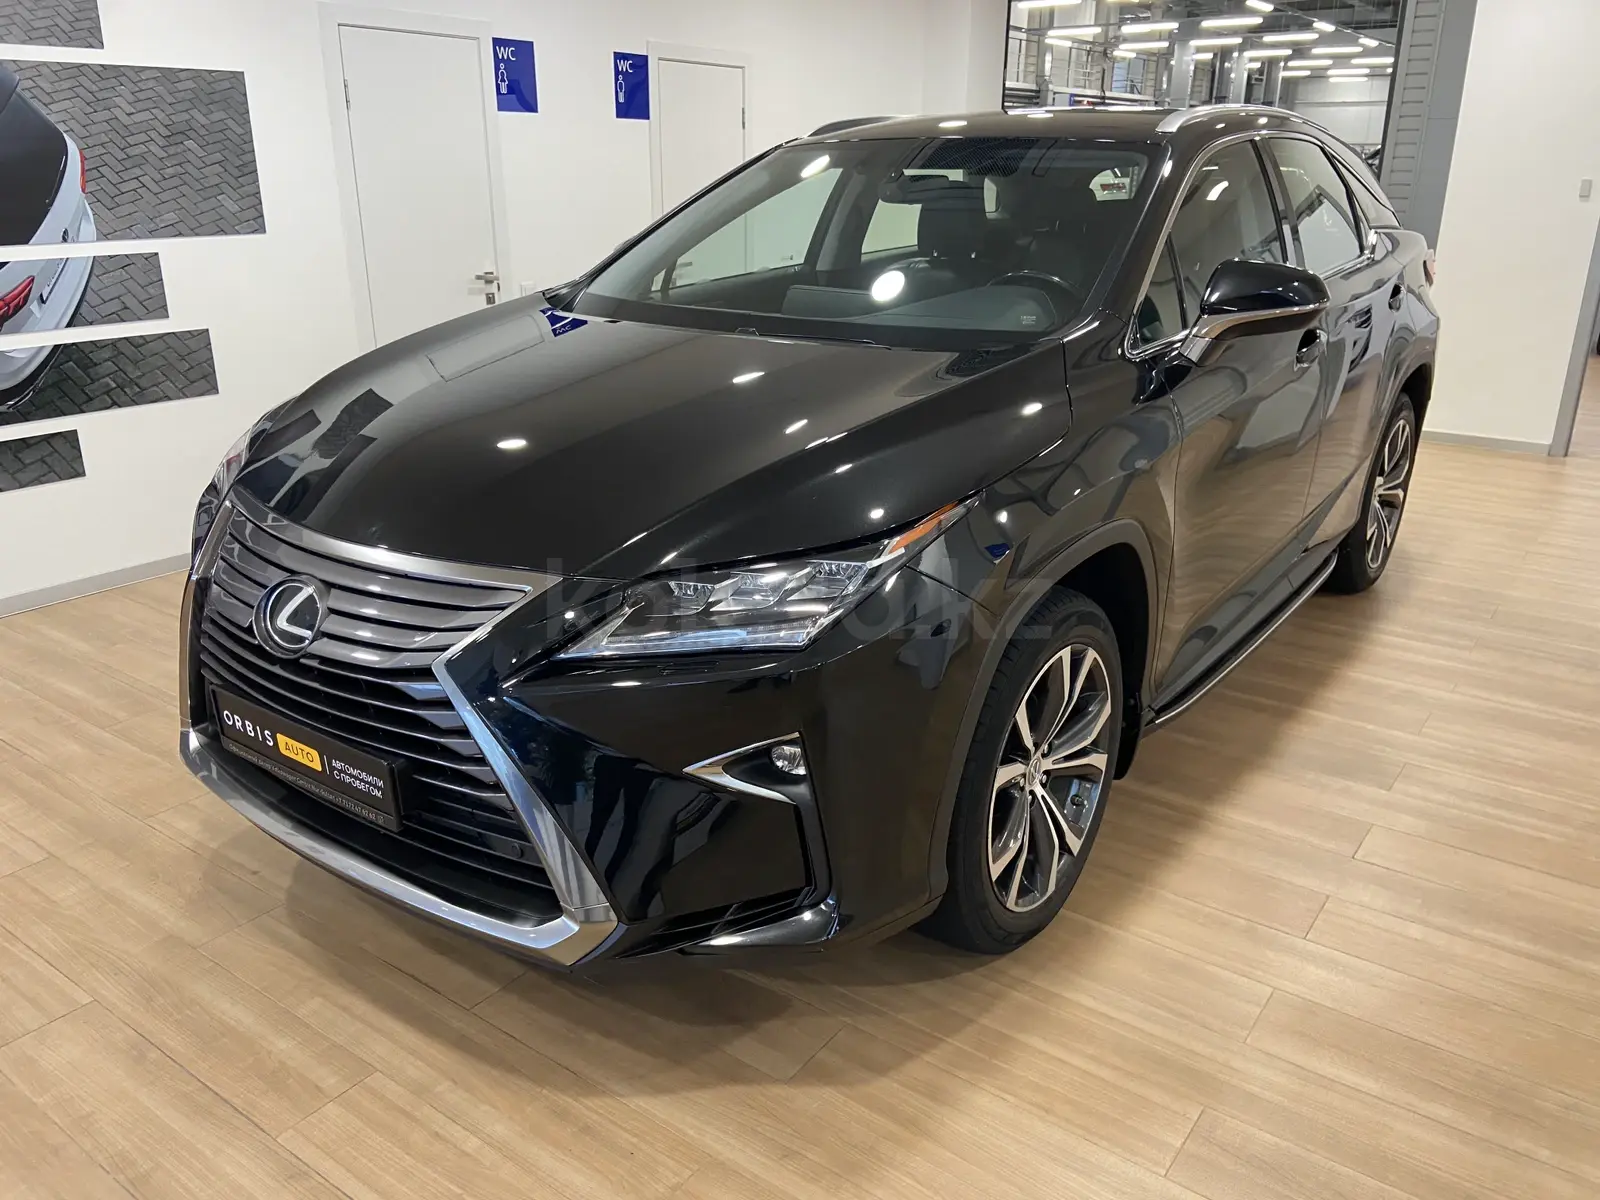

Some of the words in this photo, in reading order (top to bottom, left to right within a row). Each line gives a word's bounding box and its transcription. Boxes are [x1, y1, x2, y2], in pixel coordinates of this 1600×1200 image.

[496, 46, 517, 61] WC
[616, 59, 633, 73] WC
[223, 710, 274, 747] ORBIS
[285, 741, 315, 763] AUTO
[332, 759, 384, 788] АВТОМОБИЛИ
[333, 770, 341, 779] С
[340, 774, 383, 799] ПРОБЕГОМ
